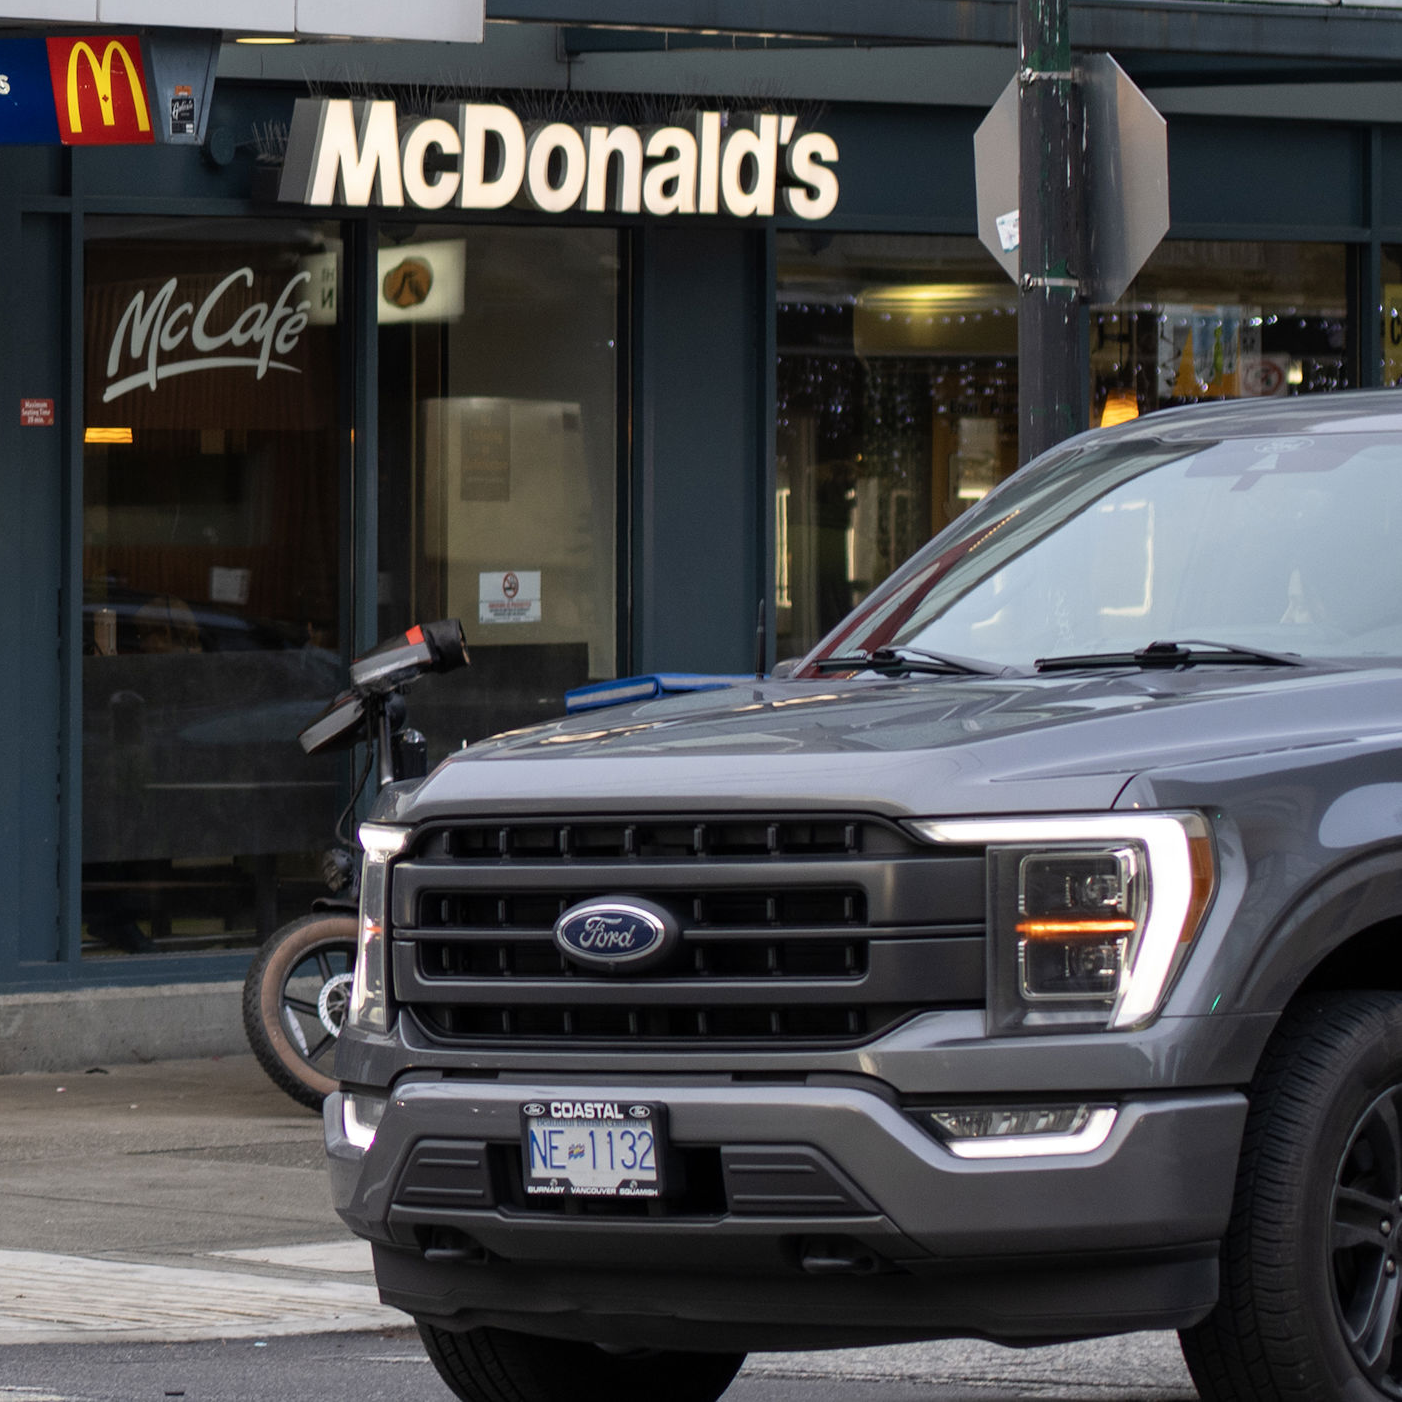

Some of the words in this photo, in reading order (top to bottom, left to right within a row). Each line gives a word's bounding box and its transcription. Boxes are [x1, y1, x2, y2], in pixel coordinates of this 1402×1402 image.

[305, 99, 839, 221] McDonald's
[105, 267, 313, 391] McCafé
[579, 916, 636, 949] Ford
[550, 1101, 624, 1119] COASTAL
[529, 1129, 567, 1170] NE
[588, 1130, 656, 1171] 1132
[527, 1186, 565, 1194] BURNABY
[571, 1186, 617, 1195] VANCOUVER
[619, 1187, 659, 1196] SQUAMISH
